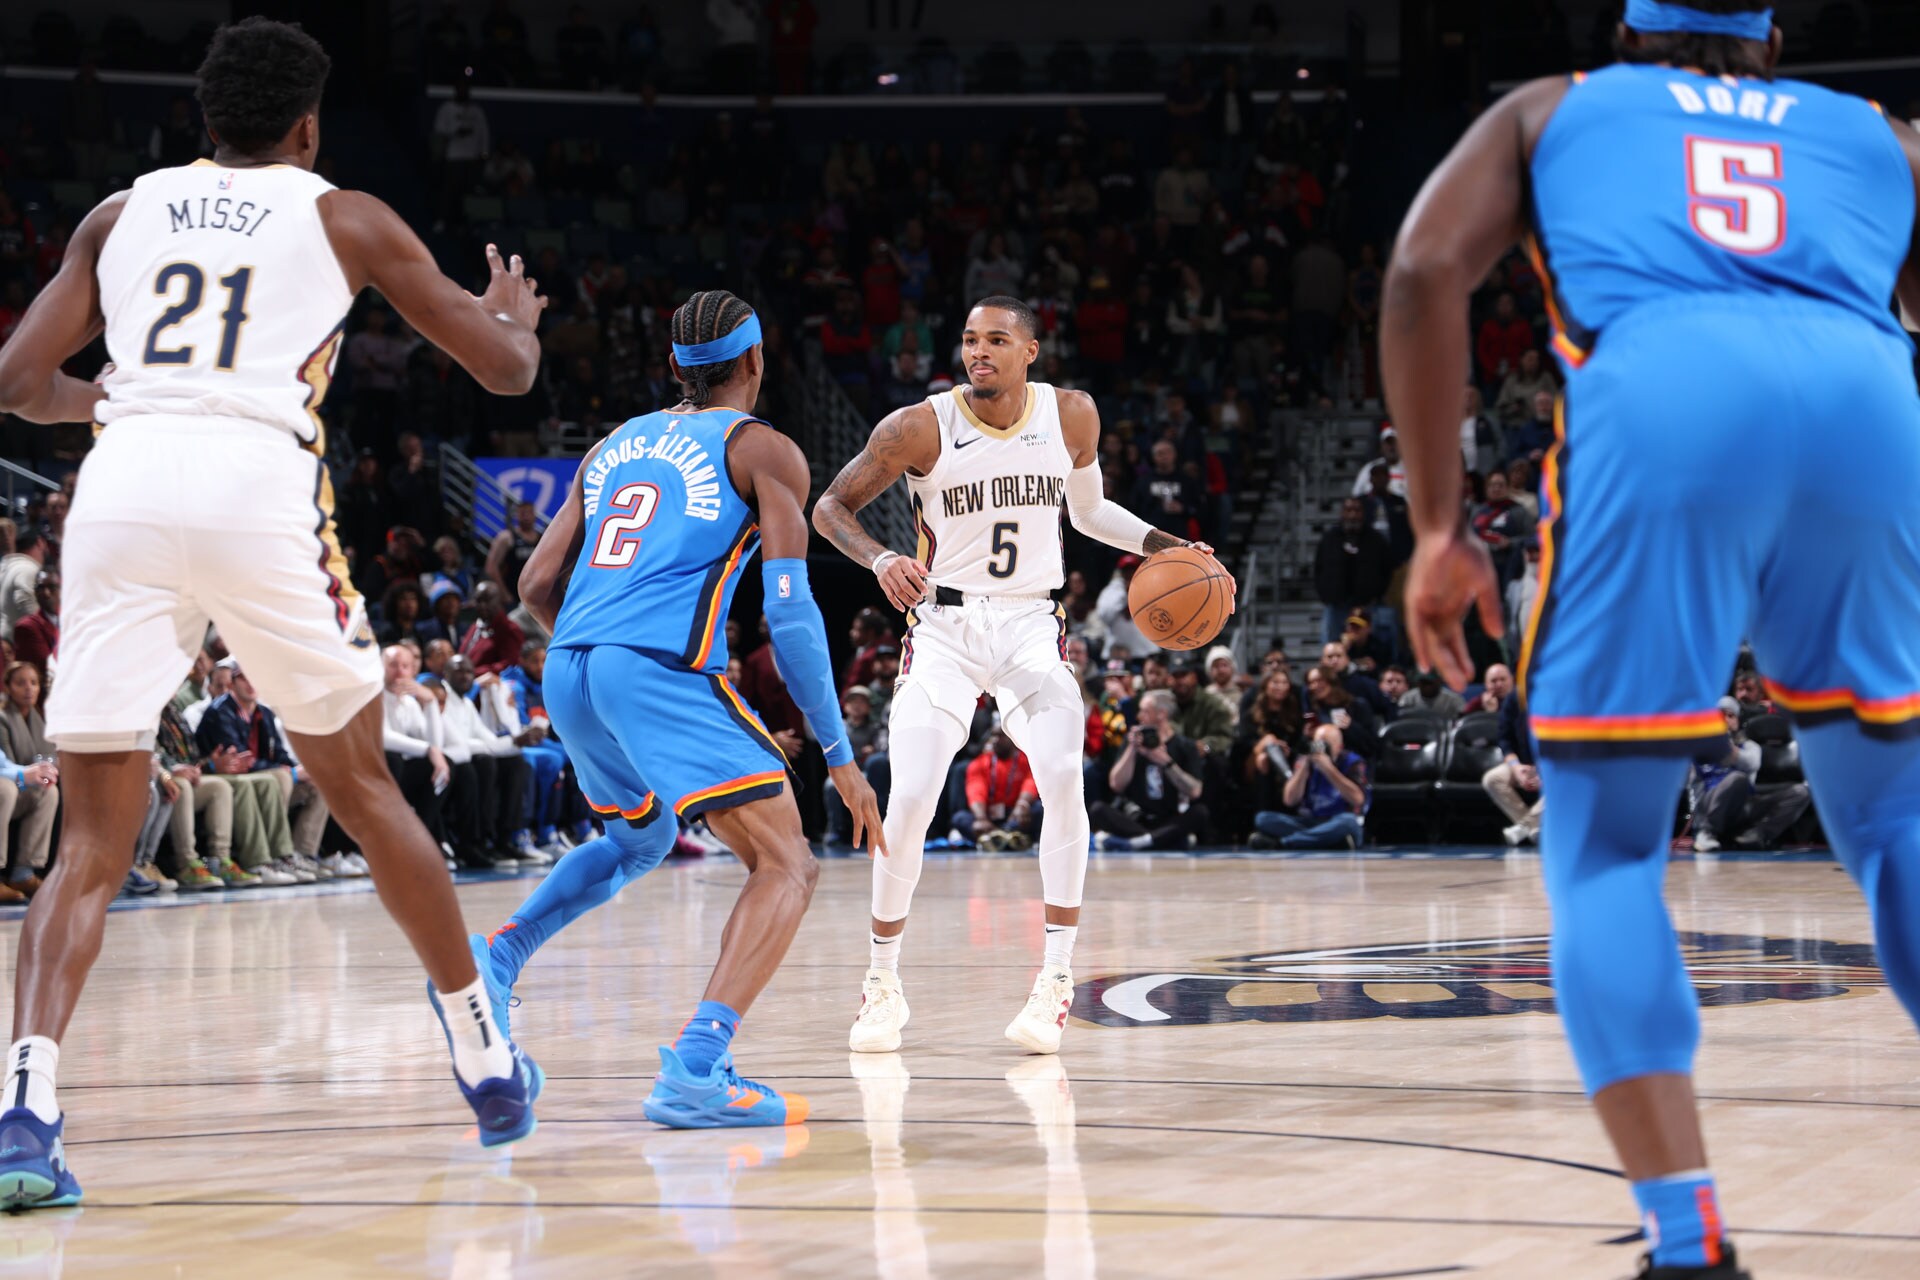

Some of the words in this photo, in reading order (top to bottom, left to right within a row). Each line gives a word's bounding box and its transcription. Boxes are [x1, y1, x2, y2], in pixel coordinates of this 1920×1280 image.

[1666, 81, 1799, 126] DORT
[166, 197, 272, 236] MISSI
[1683, 133, 1787, 256] 5
[142, 259, 255, 372] 21
[588, 481, 662, 569] 2
[941, 480, 985, 518] NEW
[991, 475, 1064, 508] ORLEANS
[987, 521, 1020, 581] 5
